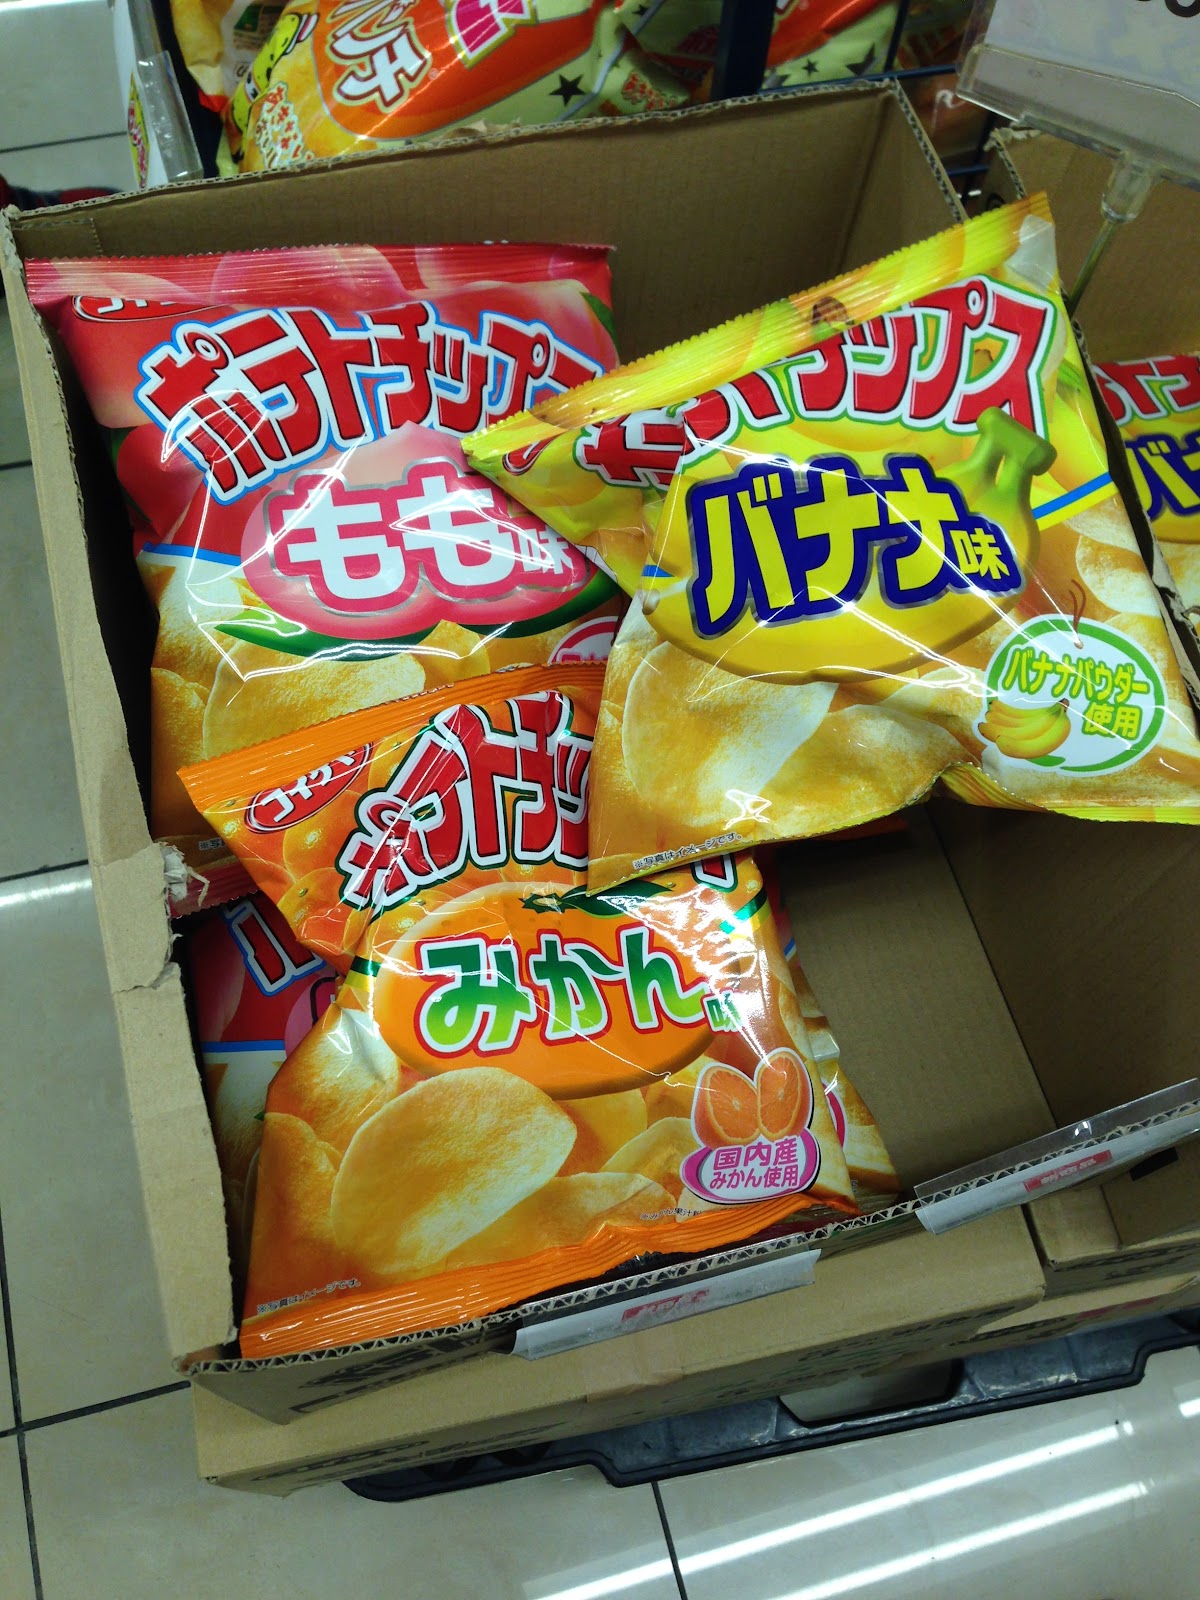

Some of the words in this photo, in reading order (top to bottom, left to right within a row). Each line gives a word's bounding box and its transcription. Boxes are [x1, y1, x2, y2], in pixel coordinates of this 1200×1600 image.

[272, 460, 590, 608] もも味
[690, 455, 1025, 636] バナナ味
[1003, 647, 1150, 703] バナナパウダー
[1082, 702, 1142, 740] 使用
[709, 1165, 799, 1189] みかん使用
[713, 1138, 798, 1170] 国内産
